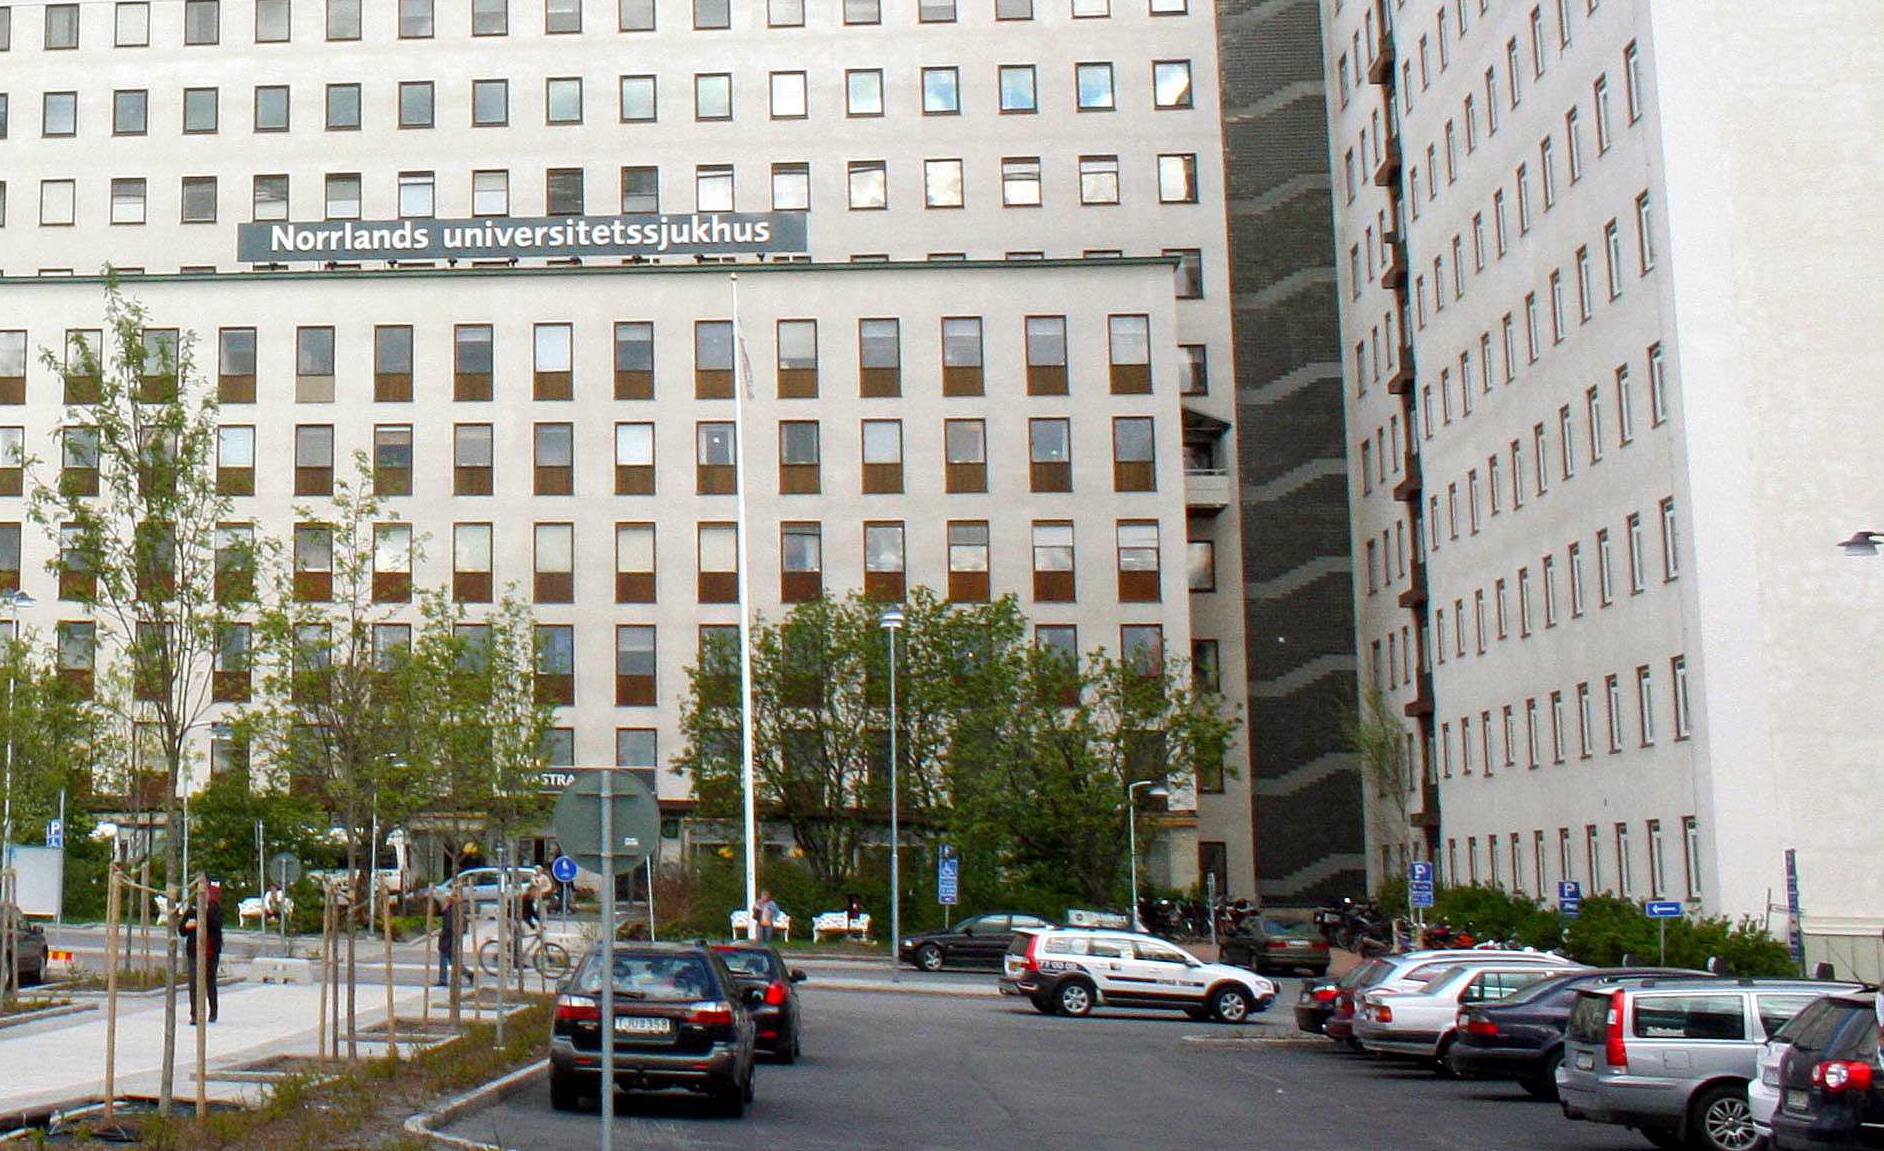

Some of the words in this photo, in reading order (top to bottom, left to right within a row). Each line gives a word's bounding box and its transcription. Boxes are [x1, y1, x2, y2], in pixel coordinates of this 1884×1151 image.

[271, 221, 429, 251] Norrlands
[443, 214, 772, 251] universitetssjukhus
[51, 821, 60, 835] P
[1415, 864, 1426, 879] P
[1564, 882, 1575, 897] P
